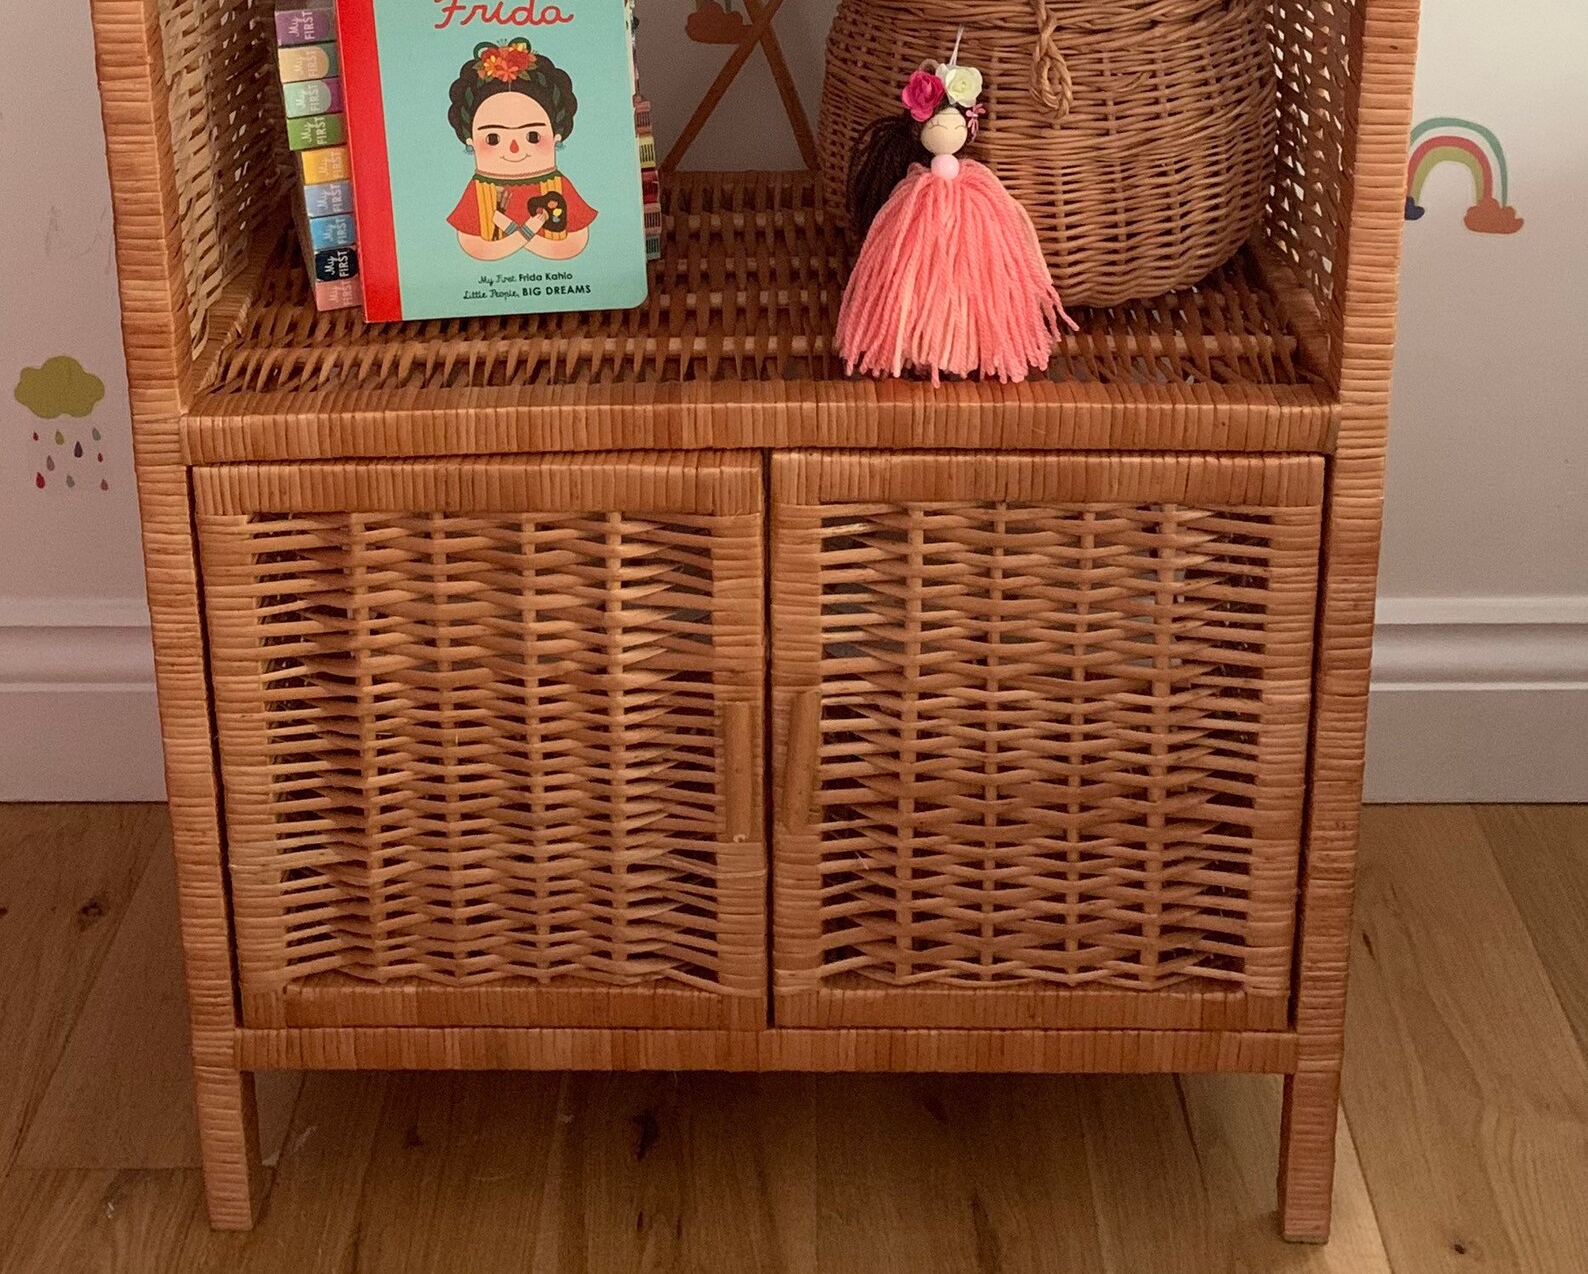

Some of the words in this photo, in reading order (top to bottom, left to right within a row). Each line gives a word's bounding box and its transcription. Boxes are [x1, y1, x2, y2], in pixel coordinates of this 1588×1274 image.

[288, 16, 304, 37] My
[302, 11, 315, 40] FIRST
[306, 51, 319, 78] FIRST
[308, 85, 320, 112] FIRST
[301, 122, 317, 143] My
[314, 117, 327, 145] FIRST
[331, 151, 344, 178] FIRST
[330, 184, 343, 213] FIRST
[336, 218, 348, 245] FIRST
[324, 255, 340, 275] My
[337, 251, 350, 278] FIRST
[478, 275, 494, 286] My
[496, 274, 517, 284] First
[518, 272, 543, 282] Frida
[545, 271, 573, 281] Kahlo
[342, 280, 353, 306] FIRST
[463, 290, 488, 300] Little
[489, 288, 520, 301] People,
[522, 287, 541, 297] BIG
[545, 284, 592, 295] DREAMS
